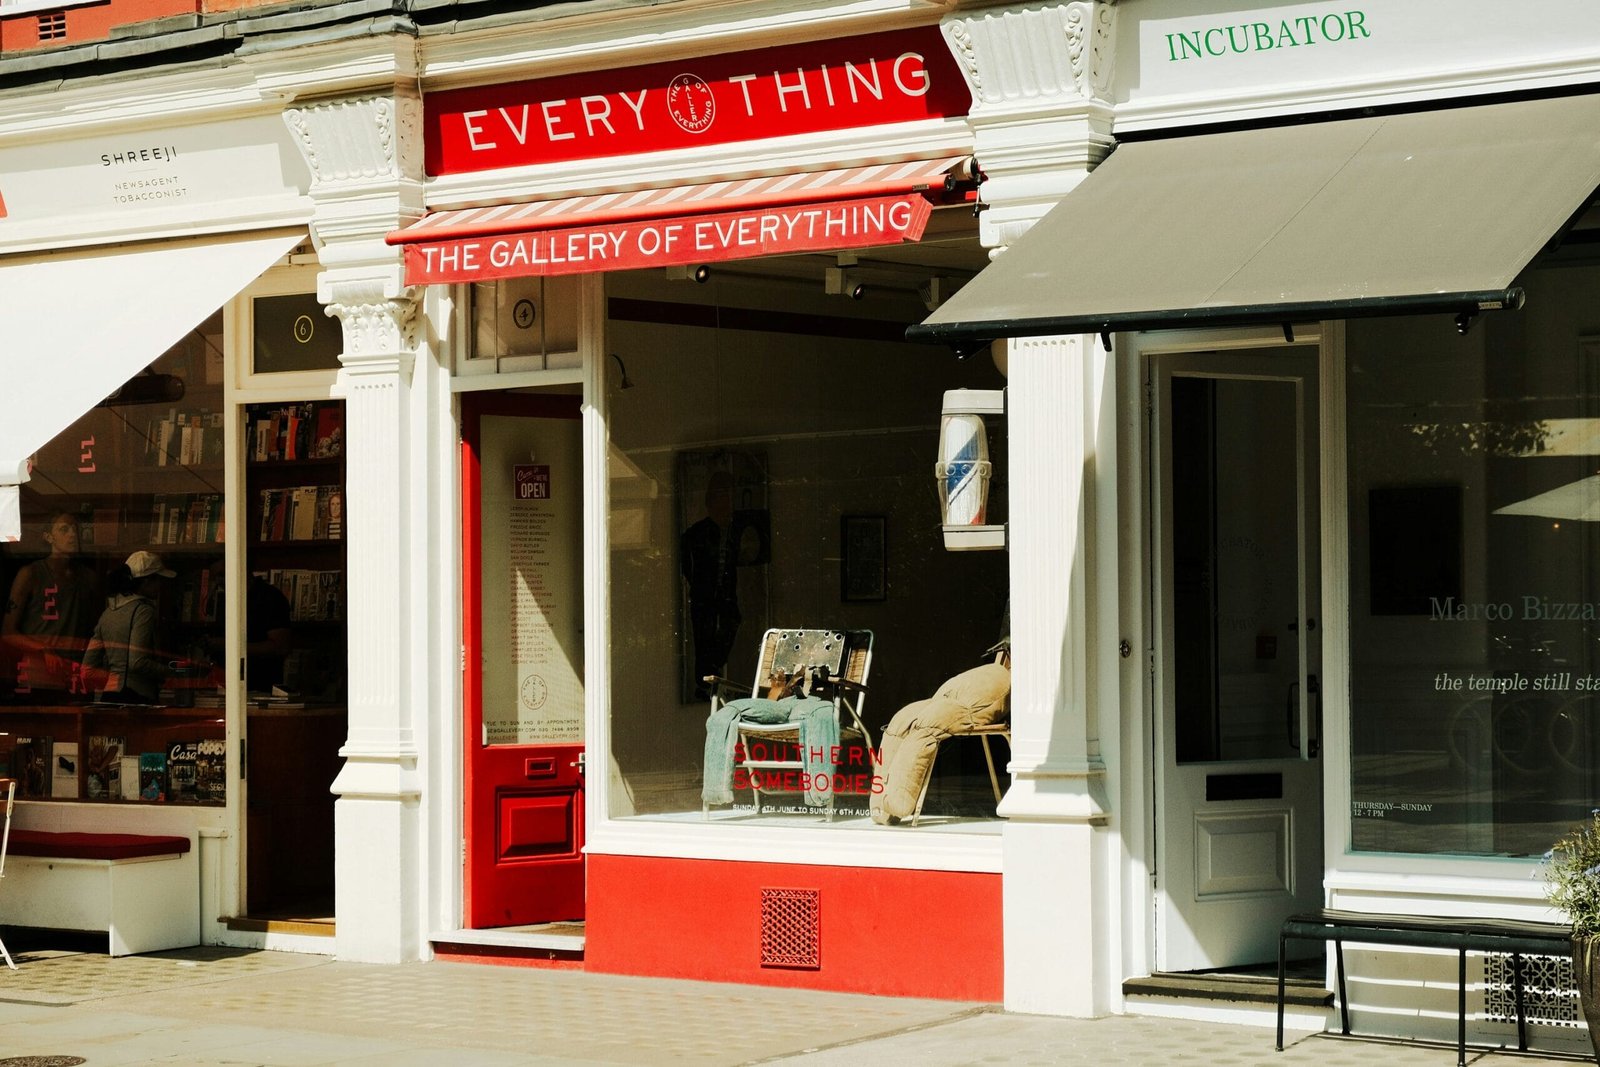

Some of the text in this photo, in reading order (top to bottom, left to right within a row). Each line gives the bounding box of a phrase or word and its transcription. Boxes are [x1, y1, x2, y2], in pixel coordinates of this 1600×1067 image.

[1166, 10, 1371, 62] INCUBATOR
[463, 51, 931, 151] EVERY THING
[101, 146, 177, 167] SHREEJI
[115, 176, 178, 190] NEWSAGENT
[113, 188, 187, 203] TOBACCONIST
[421, 201, 912, 273] THE GALLERY OF EVERYTHING
[300, 322, 307, 336] 6
[521, 483, 546, 498] OPEN
[1429, 595, 1600, 621] Marco Bizza
[1434, 672, 1463, 691] the
[1467, 672, 1529, 695] temple
[1532, 672, 1571, 691] still
[170, 744, 197, 761] Casa
[734, 742, 884, 766] SOUTHERN
[734, 769, 884, 795] SOMEBODIES
[732, 804, 760, 813] SUNDAY
[777, 806, 796, 814] JUNE
[797, 806, 808, 815] TO
[809, 807, 838, 816] SUNDAY
[839, 808, 854, 816] 6TH
[1354, 809, 1362, 817] 12
[1372, 809, 1385, 818] PM
